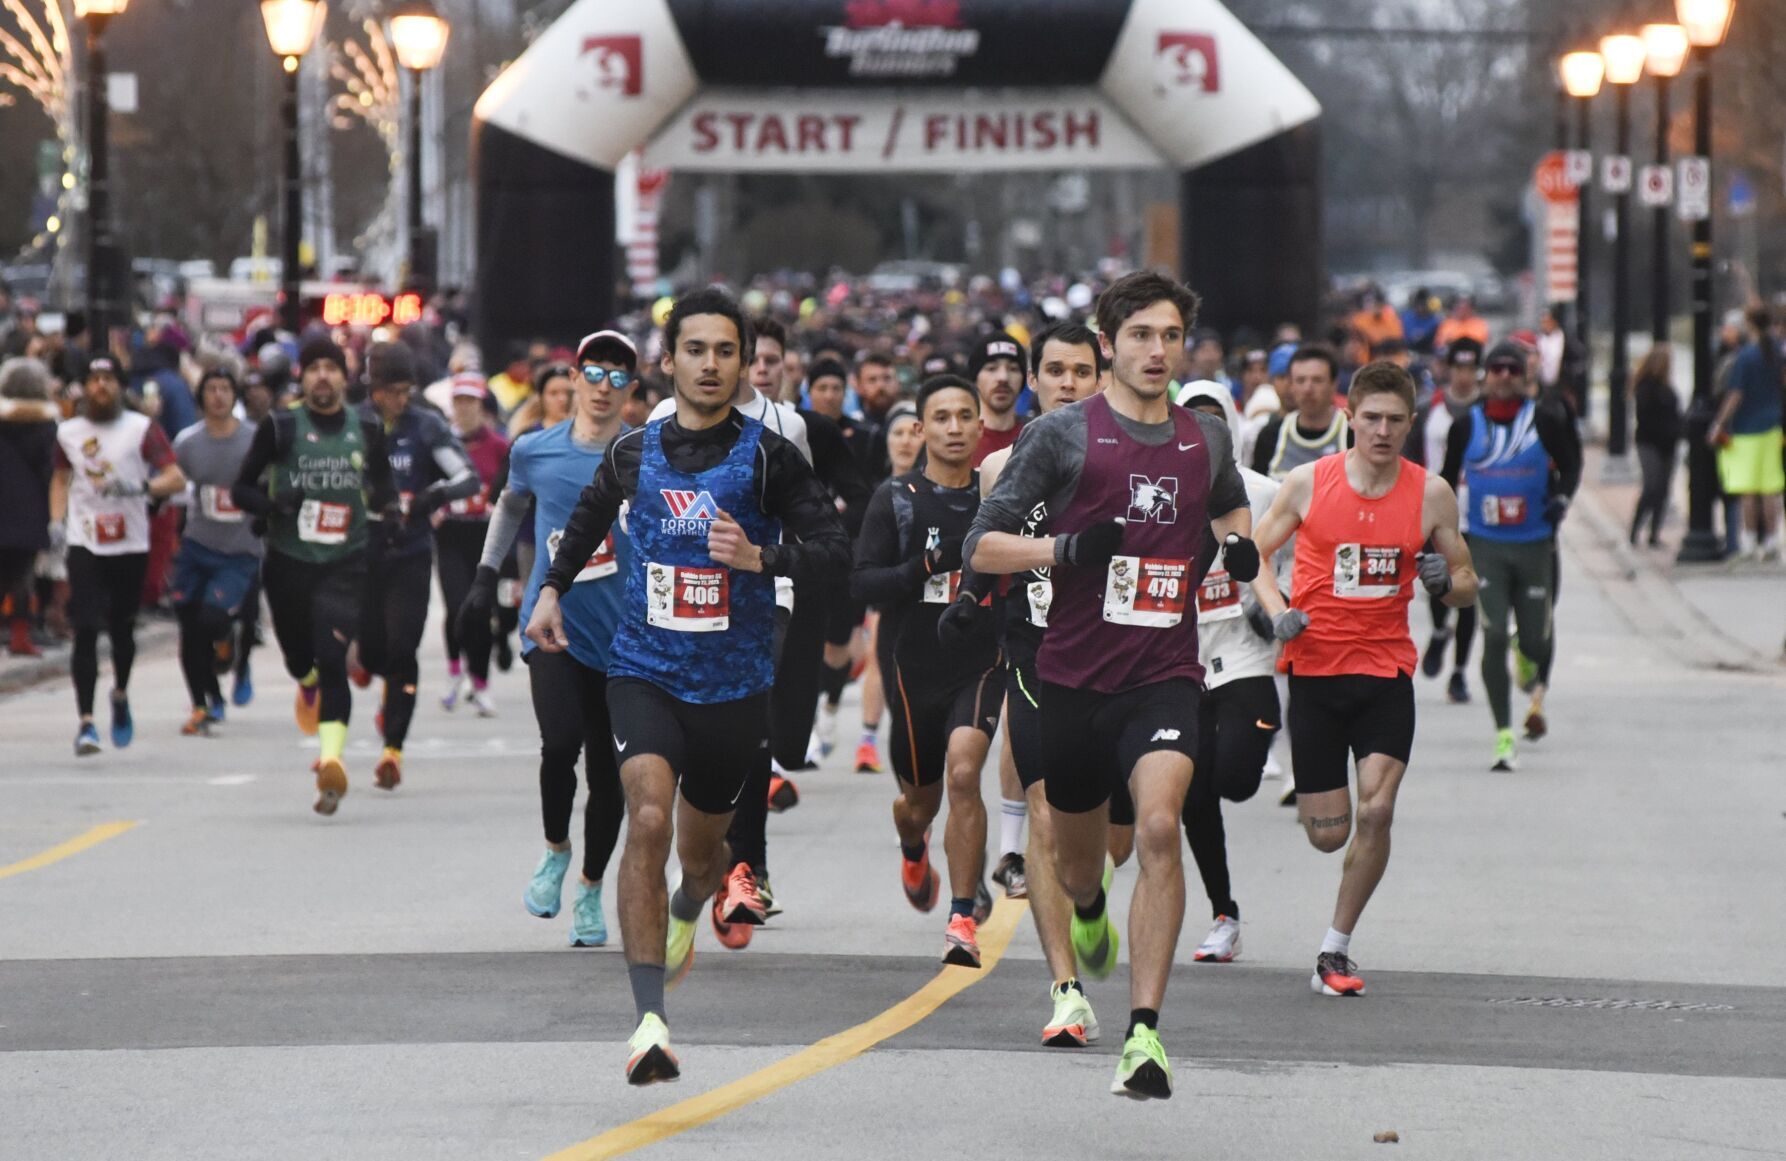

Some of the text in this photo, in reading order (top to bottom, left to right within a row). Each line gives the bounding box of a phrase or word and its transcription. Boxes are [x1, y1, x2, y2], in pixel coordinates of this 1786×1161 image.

[692, 108, 1100, 161] START / FINISH
[660, 518, 713, 530] TORON
[1367, 558, 1397, 575] 344
[683, 586, 719, 605] 406
[1147, 577, 1179, 599] 479
[1205, 582, 1231, 600] 473
